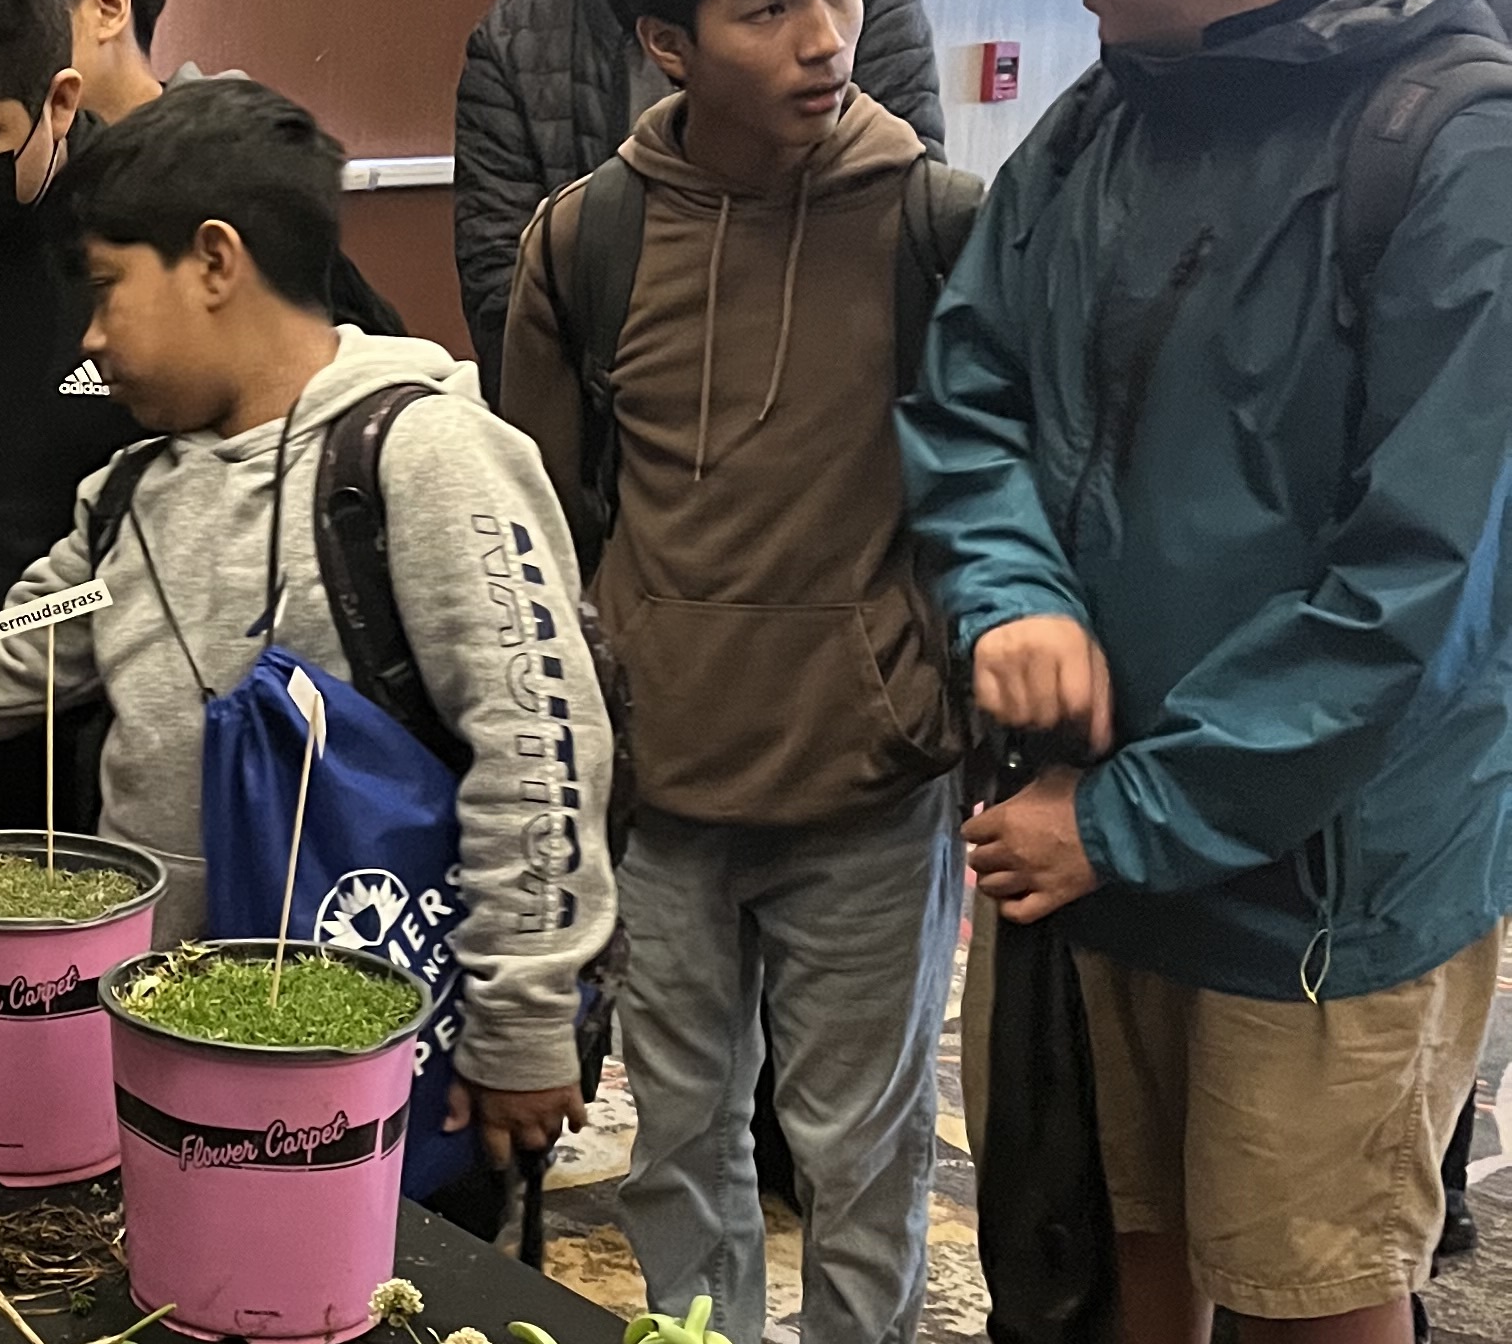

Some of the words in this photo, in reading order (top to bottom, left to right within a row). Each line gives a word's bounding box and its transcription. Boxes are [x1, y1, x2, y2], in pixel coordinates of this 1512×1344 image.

[58, 381, 111, 396] adidas
[9, 965, 80, 1014] Carpet
[178, 1133, 259, 1171] Flower
[264, 1111, 349, 1164] Carpet
